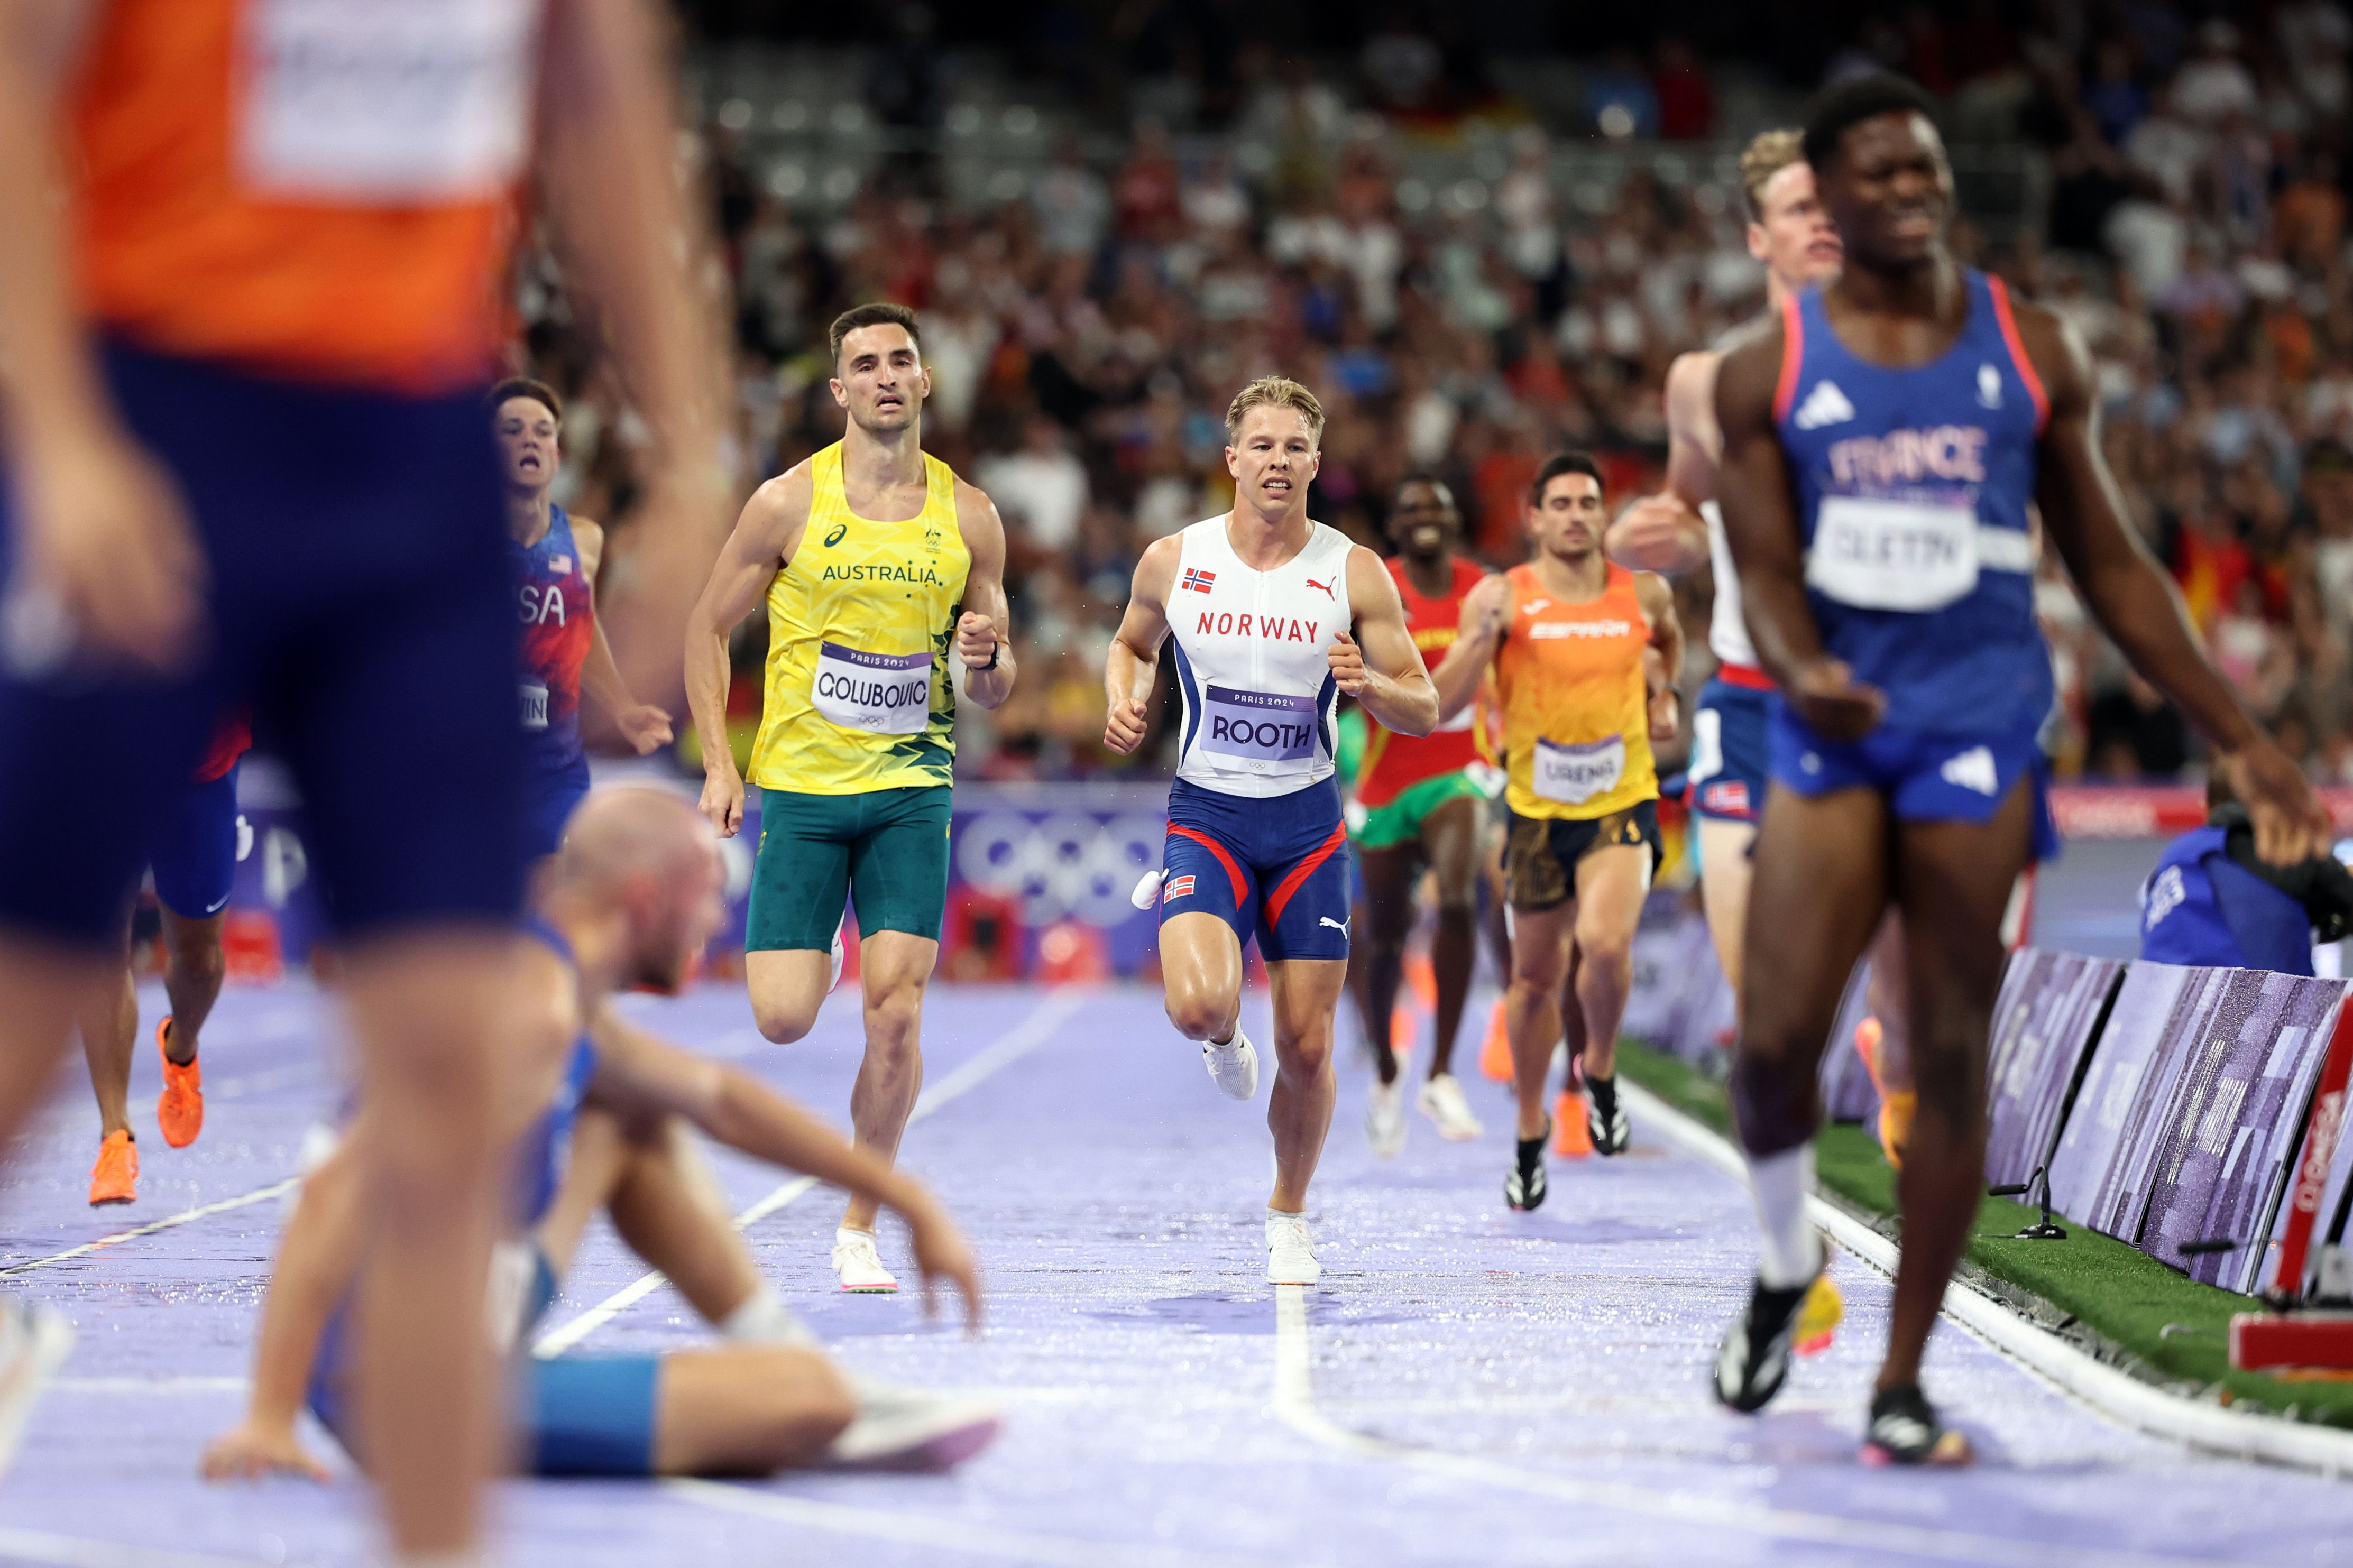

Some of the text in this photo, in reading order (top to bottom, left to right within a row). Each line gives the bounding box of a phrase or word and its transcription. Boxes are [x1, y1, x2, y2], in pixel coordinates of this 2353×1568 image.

[823, 565, 936, 584] AUSTRALIA
[518, 584, 565, 628] SA
[1197, 612, 1318, 643] NORWAY
[851, 653, 880, 665] PARIS
[819, 672, 926, 708] GOLUBOVIC
[1235, 694, 1294, 707] PARIS 2024
[1212, 715, 1311, 749] ROOTH
